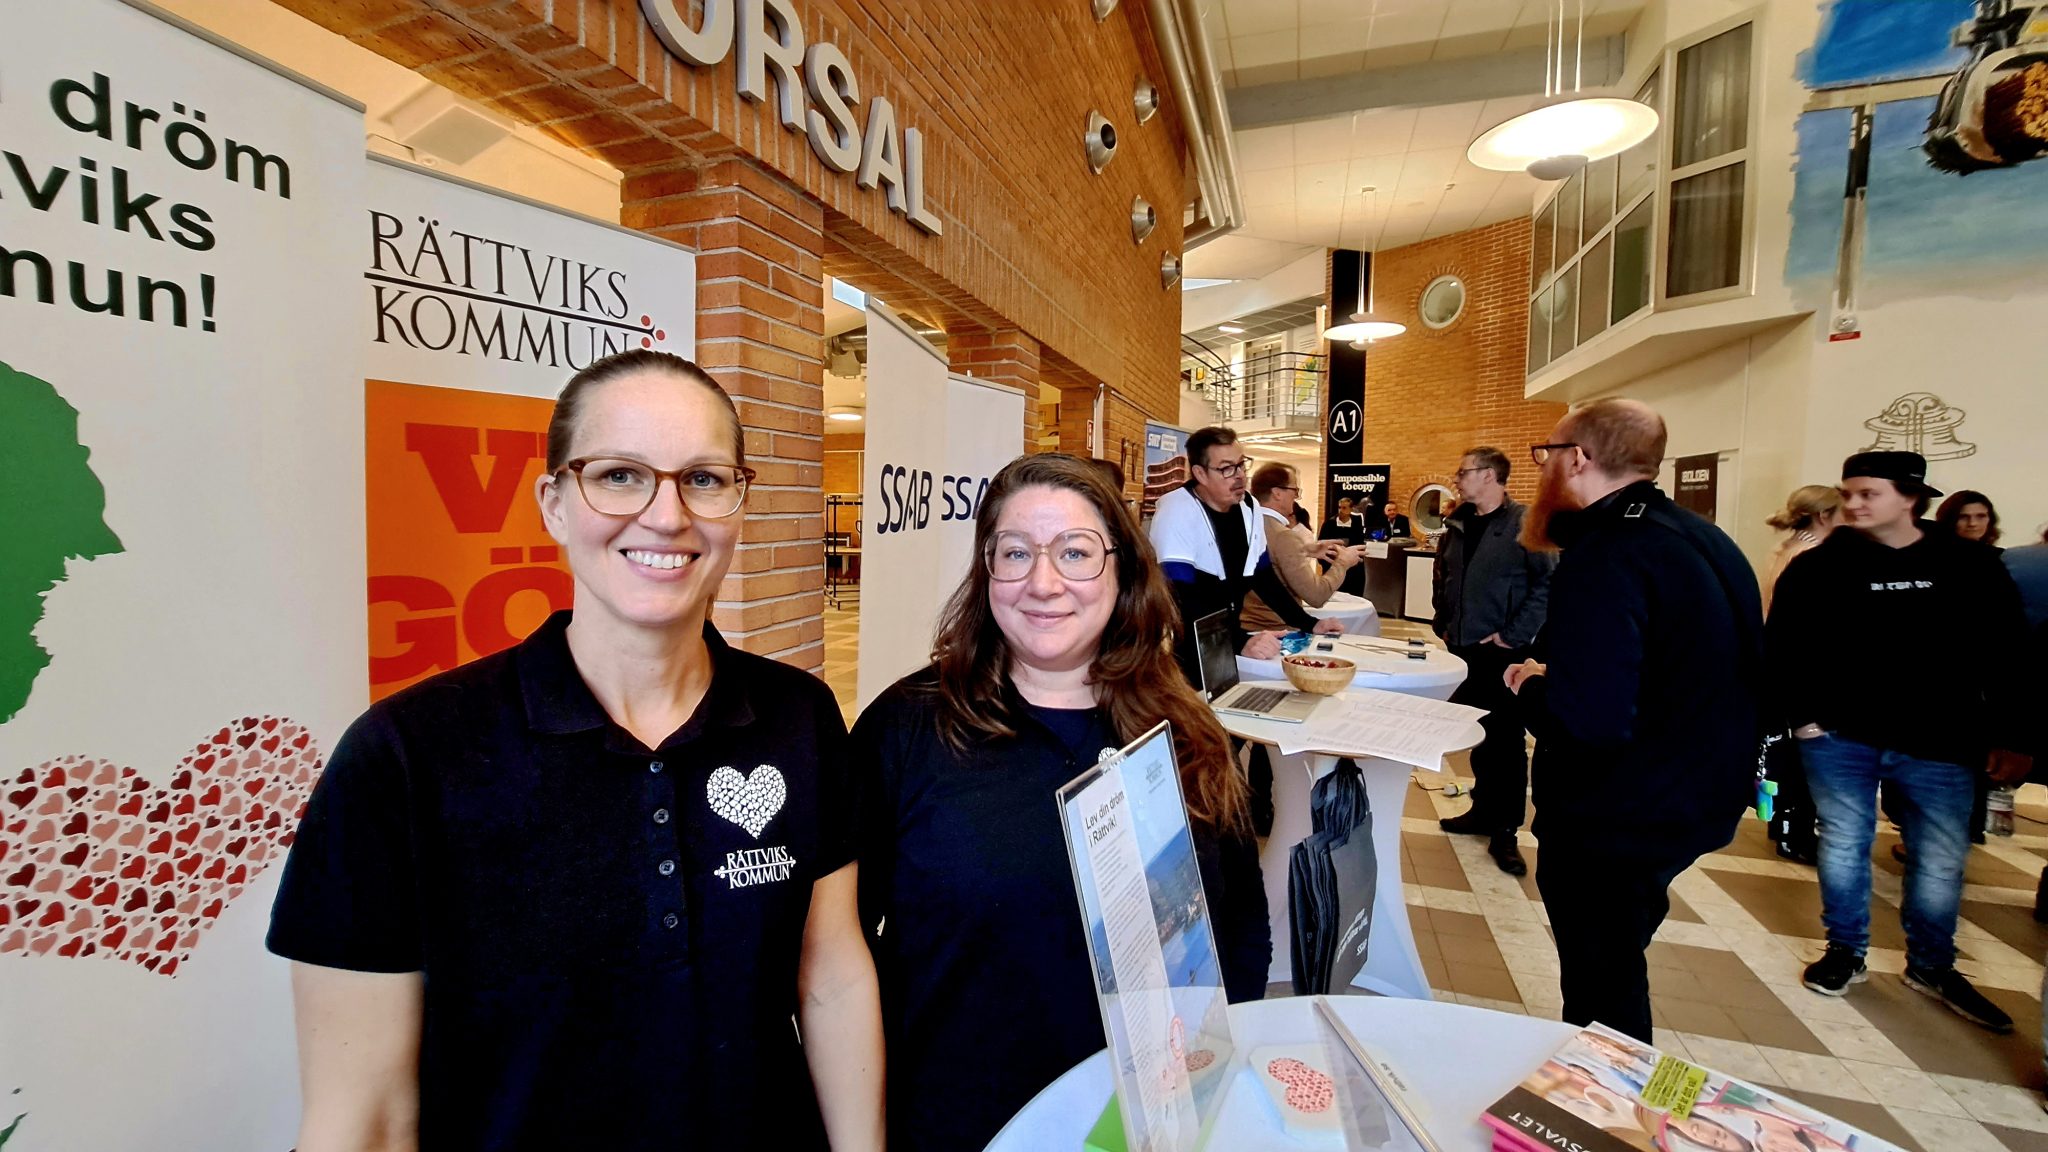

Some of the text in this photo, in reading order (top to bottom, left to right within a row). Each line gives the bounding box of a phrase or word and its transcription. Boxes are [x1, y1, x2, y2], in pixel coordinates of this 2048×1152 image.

[49, 71, 291, 200] dröm
[0, 149, 216, 252] viks
[367, 209, 628, 320] RÄTTVIKS
[1332, 409, 1357, 434] A1
[404, 422, 548, 534] V
[1333, 474, 1386, 484] Impossible
[1342, 482, 1375, 493] to copy
[877, 463, 932, 534] SSAB
[1085, 813, 1098, 830] Lev
[1098, 803, 1110, 819] din
[1088, 834, 1093, 848] i
[726, 846, 788, 870] RÄTTVIKS
[729, 864, 790, 889] KOMMUN
[1508, 1112, 1591, 1152] SVALET
